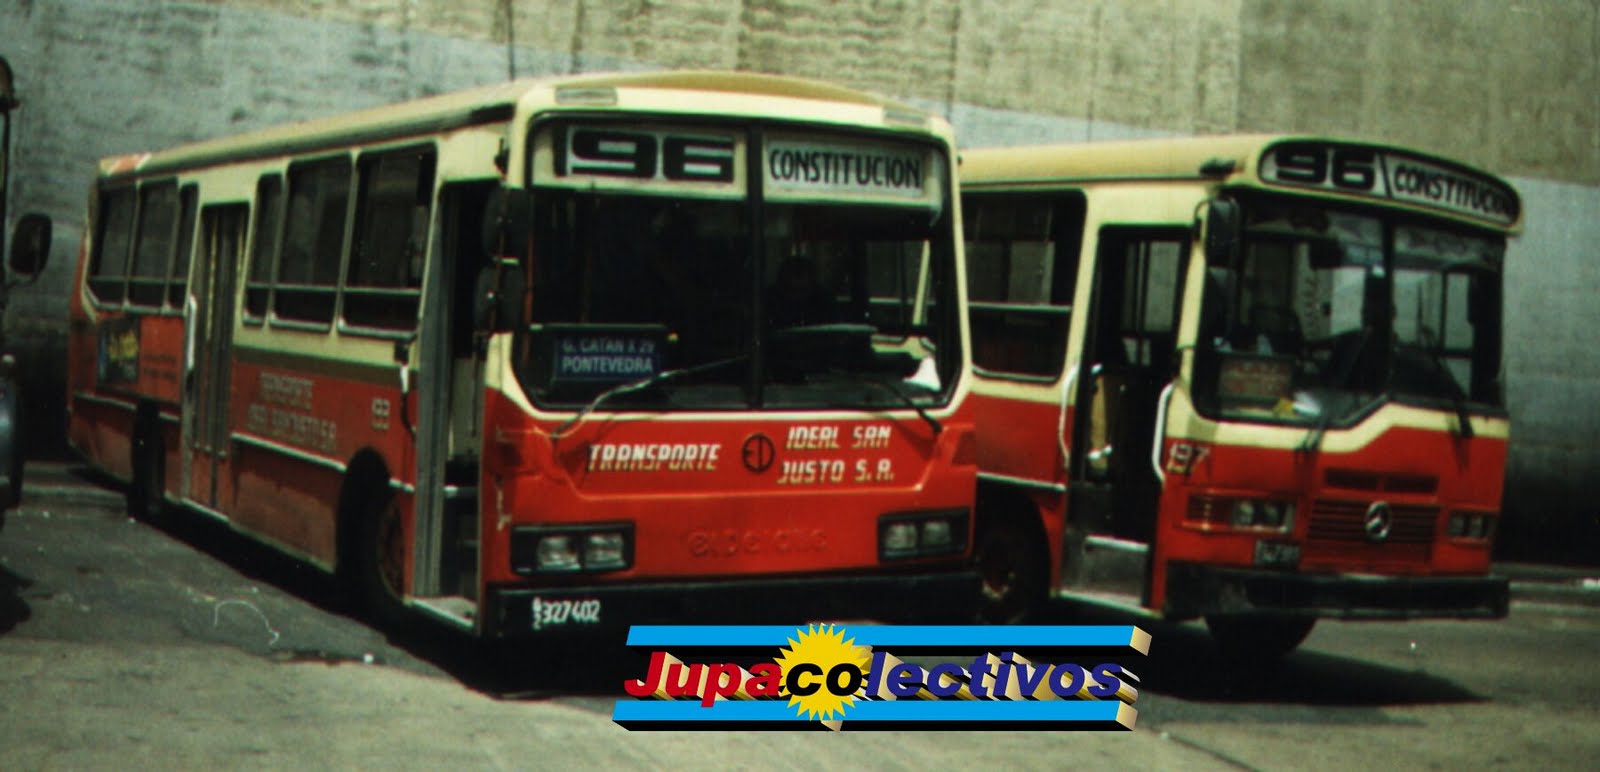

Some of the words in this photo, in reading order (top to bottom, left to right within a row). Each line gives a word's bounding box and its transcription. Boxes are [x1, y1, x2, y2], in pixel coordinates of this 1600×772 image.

[571, 129, 735, 183] 96
[769, 147, 922, 190] CONSTITUCION
[1275, 148, 1376, 191] 96
[562, 356, 654, 373] PONTEVEDRA
[786, 426, 841, 449] IDEAL
[852, 426, 892, 448] SAN
[588, 443, 722, 471] TRANSPORTE
[776, 459, 846, 485] JUSTO
